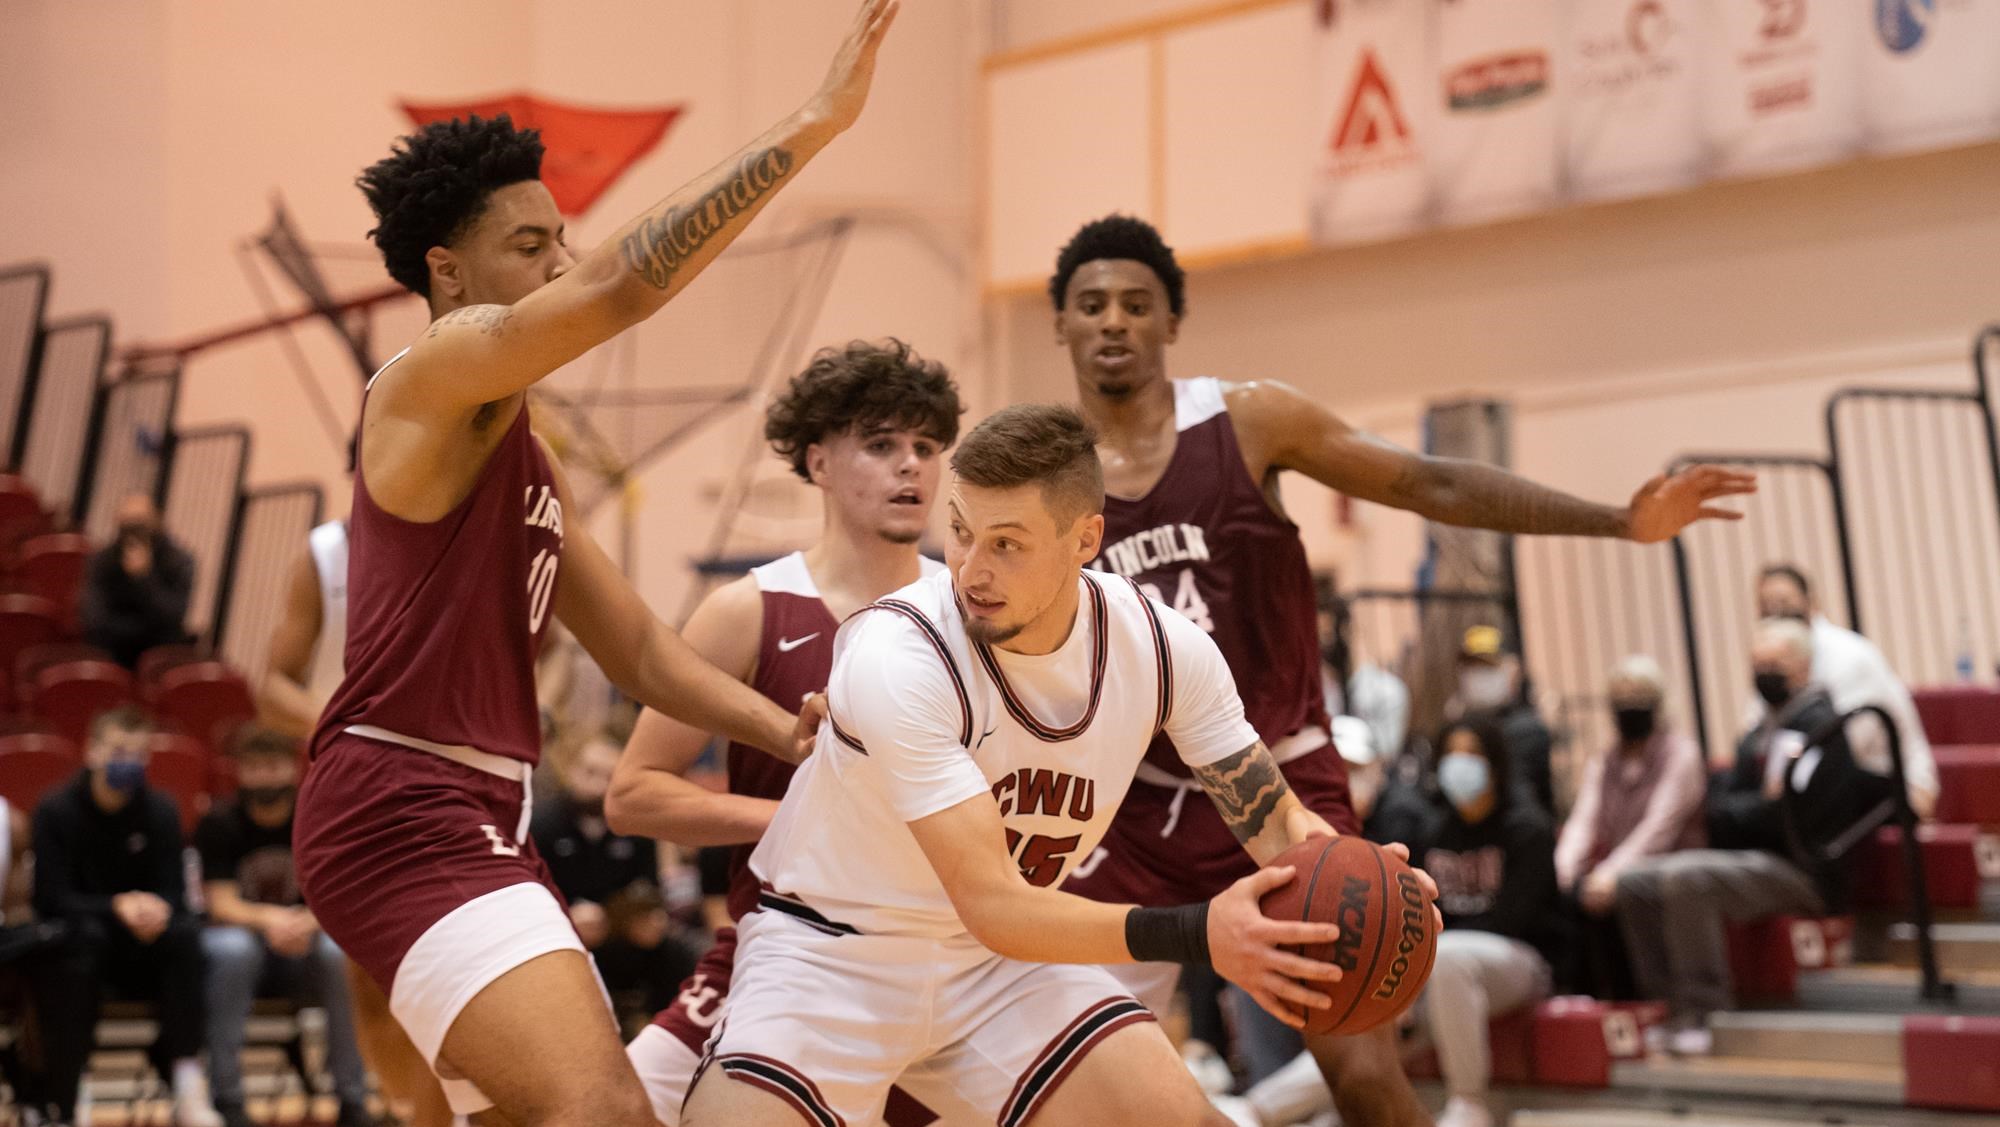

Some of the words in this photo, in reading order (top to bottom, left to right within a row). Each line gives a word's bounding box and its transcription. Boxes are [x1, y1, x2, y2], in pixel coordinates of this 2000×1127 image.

[621, 145, 793, 288] Yolanda
[526, 548, 558, 634] 10
[990, 767, 1095, 822] CWU
[1332, 874, 1371, 972] NCAA
[1370, 870, 1426, 1000] Wilson
